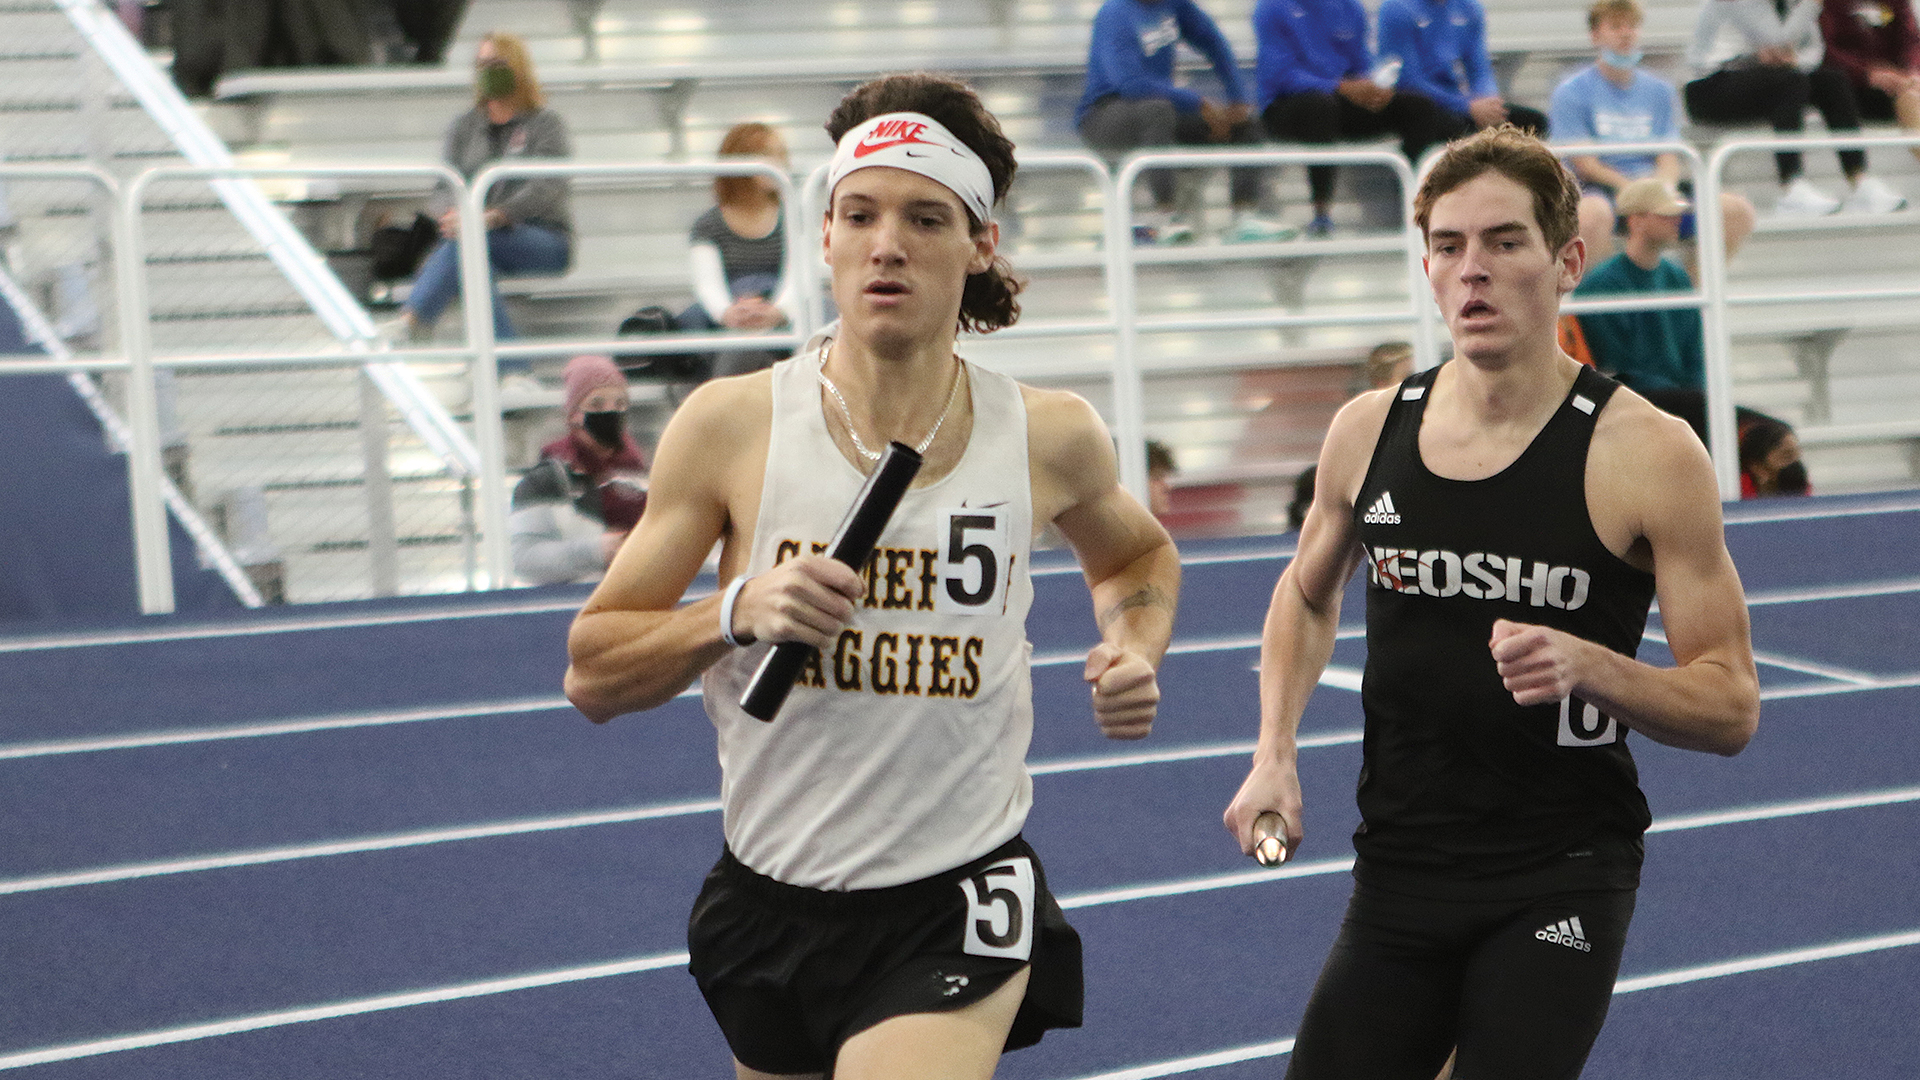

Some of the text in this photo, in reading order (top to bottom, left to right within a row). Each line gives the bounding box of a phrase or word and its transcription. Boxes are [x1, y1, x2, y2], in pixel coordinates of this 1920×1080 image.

[868, 120, 929, 142] NIKE
[1364, 511, 1401, 525] adidas
[945, 514, 998, 607] 5
[972, 865, 1023, 949] 5
[1535, 929, 1592, 953] adidas
